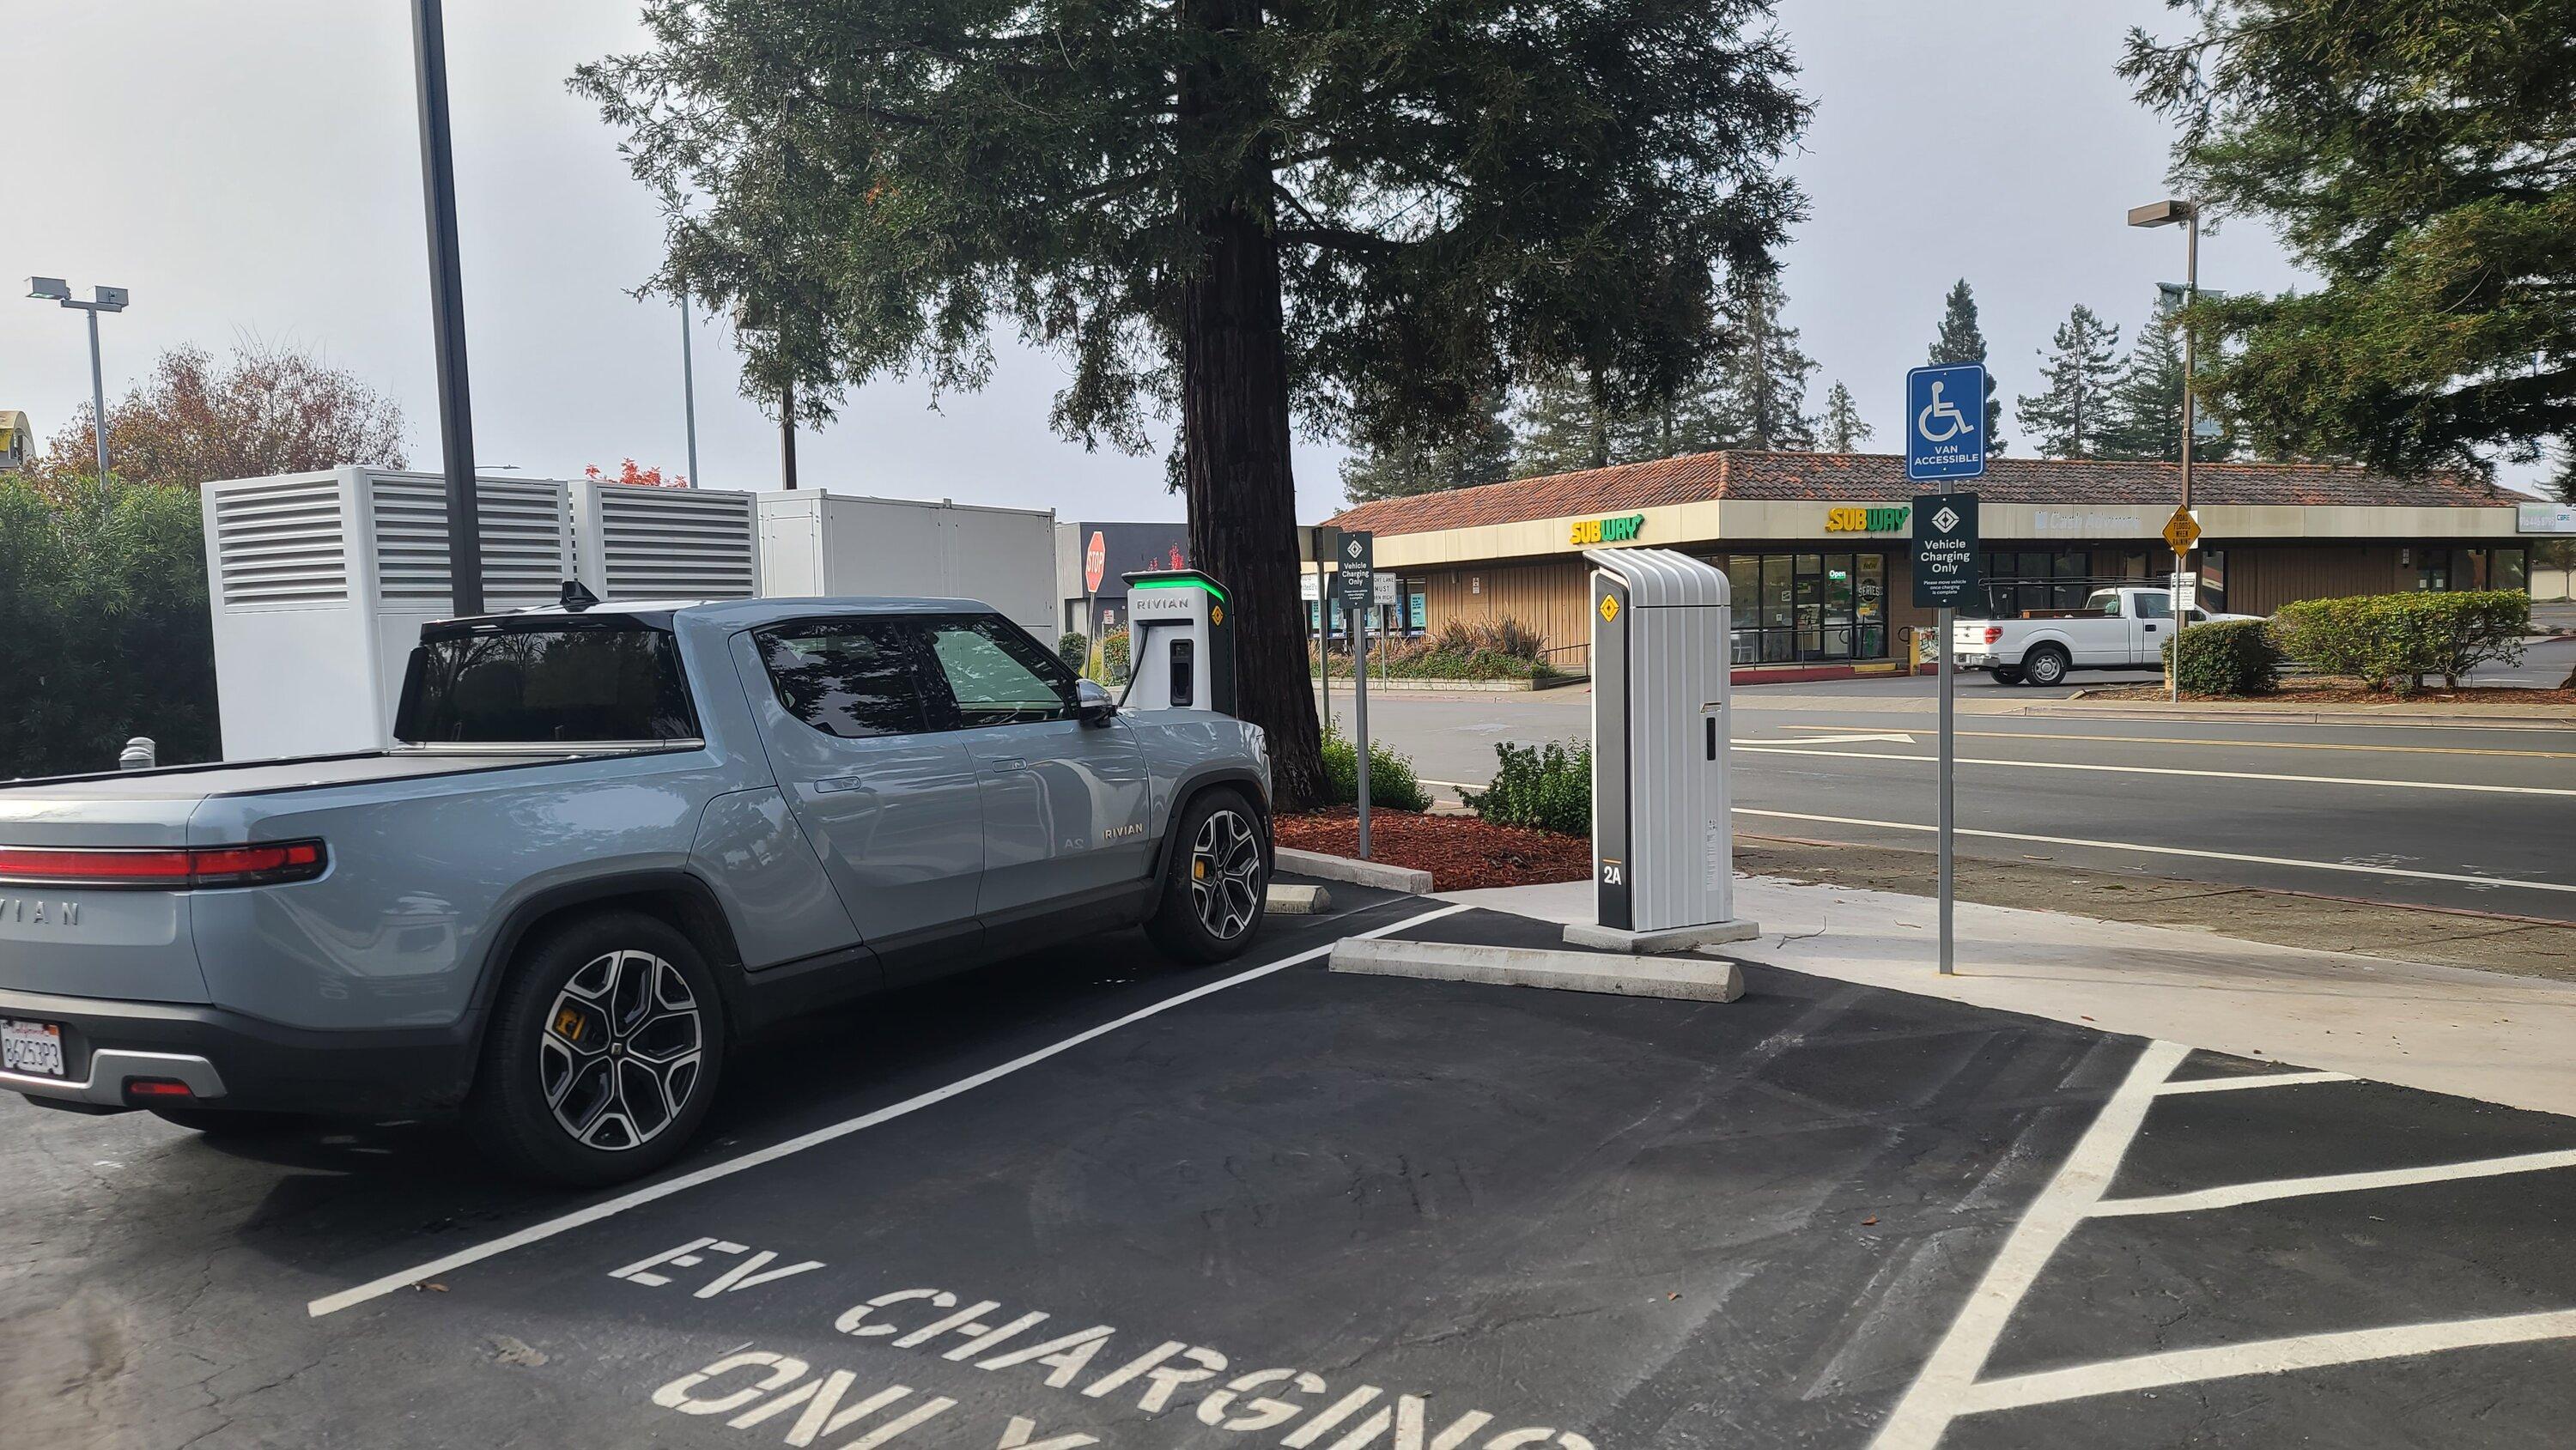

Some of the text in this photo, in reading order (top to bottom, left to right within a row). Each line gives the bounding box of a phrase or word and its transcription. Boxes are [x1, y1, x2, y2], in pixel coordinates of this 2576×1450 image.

[1935, 446, 1958, 455] VAN
[1914, 453, 1979, 466] ACCESSIBLE
[1825, 506, 1911, 532] SUBWAY
[1569, 513, 1645, 546] SUBWAY
[1924, 538, 1966, 549] Vehicle
[1087, 550, 1103, 573] STOP
[1920, 550, 1971, 563] Charging
[1341, 569, 1370, 579] Charging
[1829, 569, 1846, 579] Open
[1932, 562, 1959, 574] Only
[1348, 578, 1364, 586] Only
[1137, 598, 1188, 610] RIVIAN
[1104, 823, 1143, 840] RIVIAN
[1603, 865, 1622, 885] 2A
[607, 1236, 827, 1299] EV
